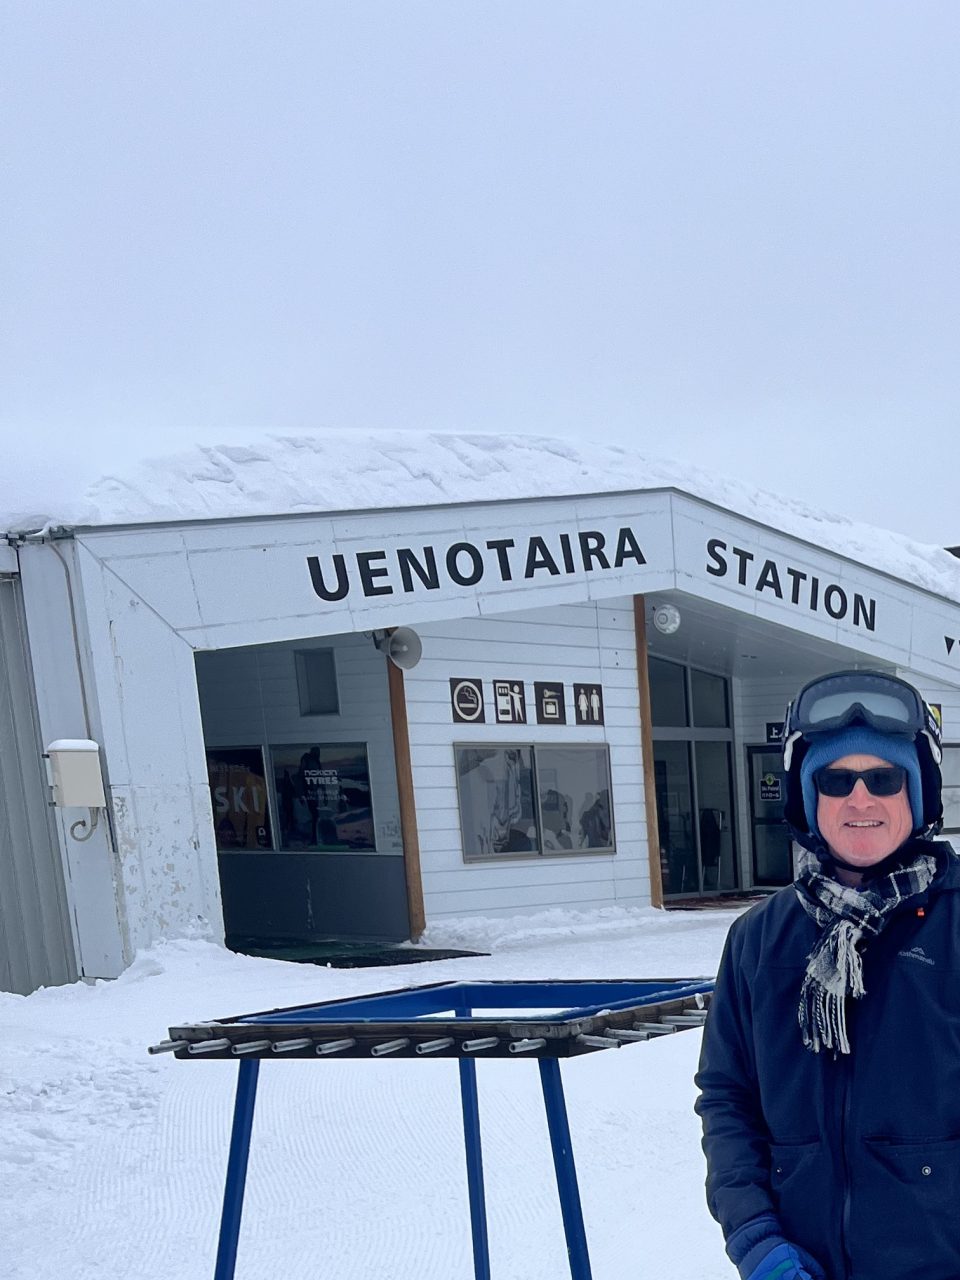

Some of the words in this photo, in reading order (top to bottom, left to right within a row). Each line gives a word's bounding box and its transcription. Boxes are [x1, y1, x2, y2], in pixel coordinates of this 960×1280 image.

[306, 527, 647, 601] UENOTAIRA
[706, 538, 876, 631] STATION
[305, 777, 338, 785] TYRES
[214, 786, 260, 813] SKI
